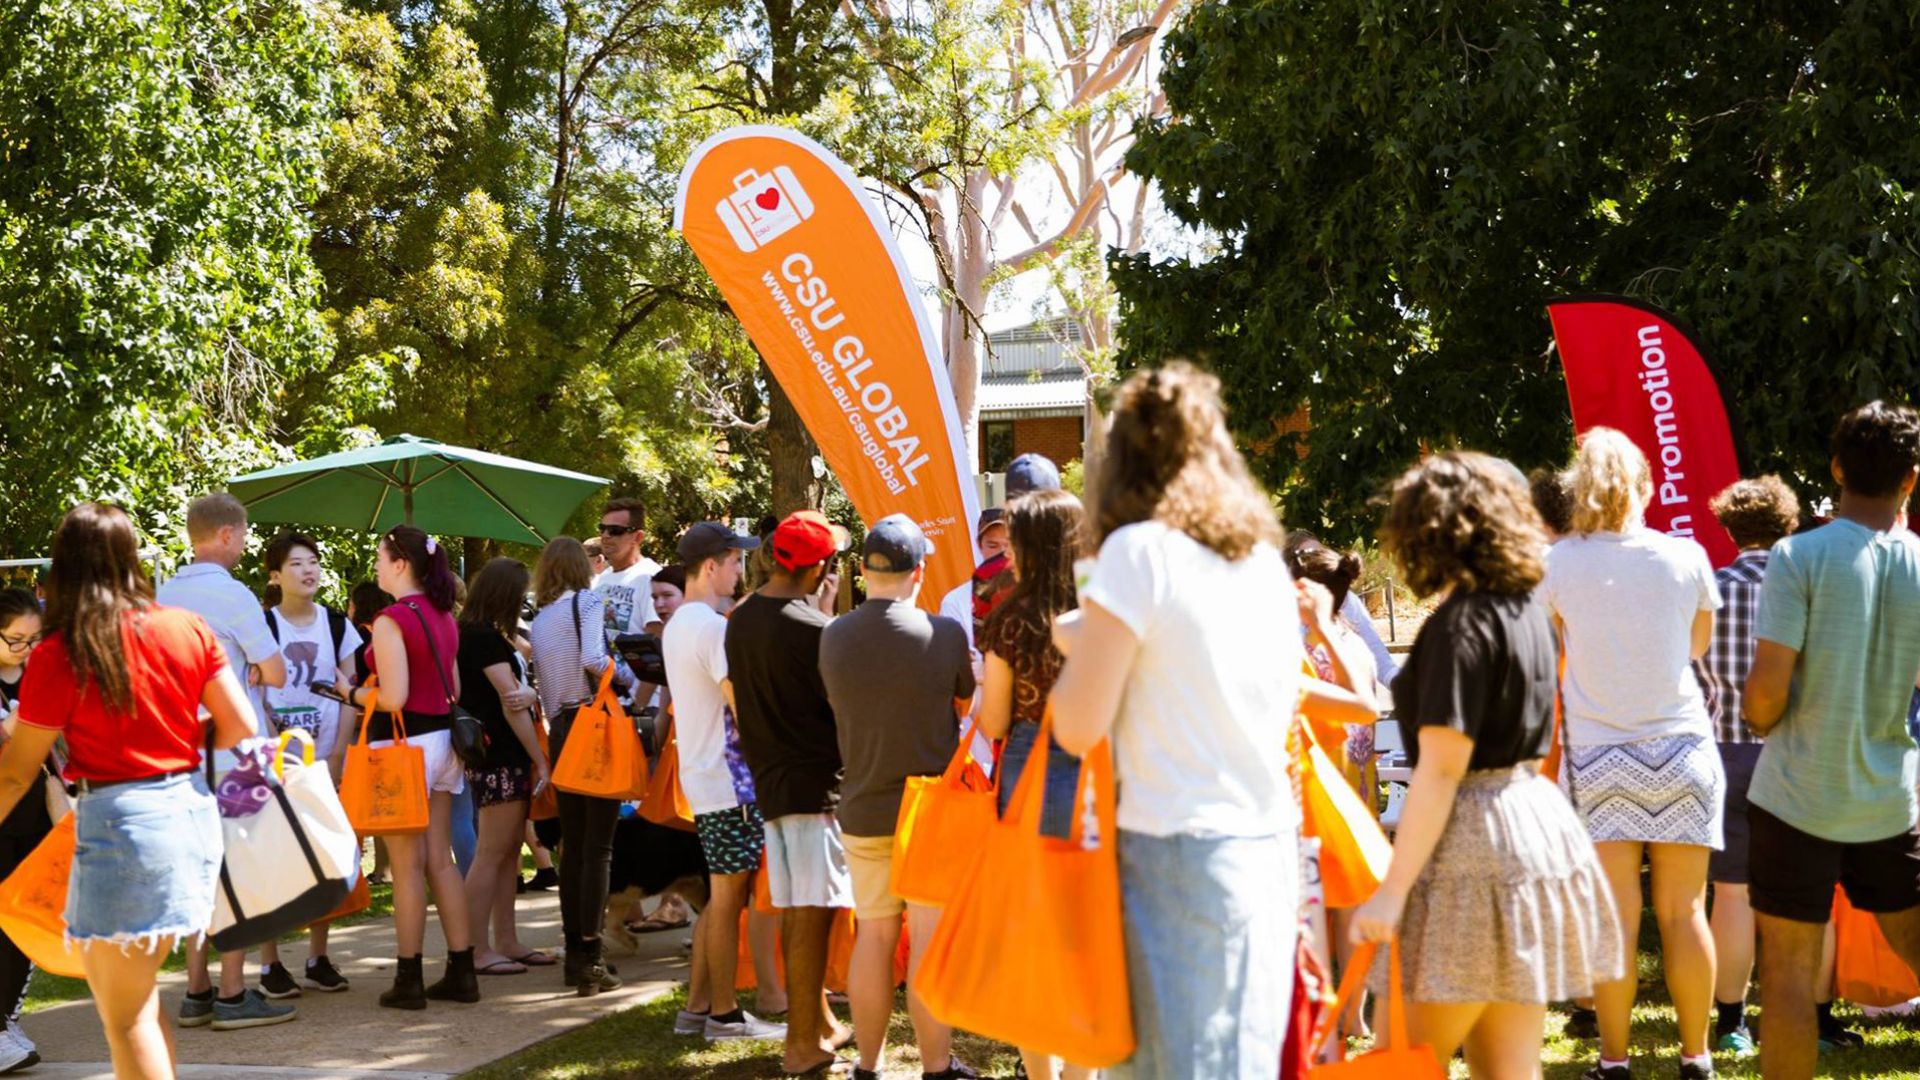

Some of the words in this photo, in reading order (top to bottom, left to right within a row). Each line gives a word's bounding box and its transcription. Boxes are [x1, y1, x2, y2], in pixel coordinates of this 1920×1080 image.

[761, 270, 907, 496] www.csu.edu.au/csuglobal
[781, 253, 845, 331] CSU
[832, 335, 930, 486] GLOBAL
[1637, 325, 1688, 505] Promotion
[282, 711, 322, 727] BARE
